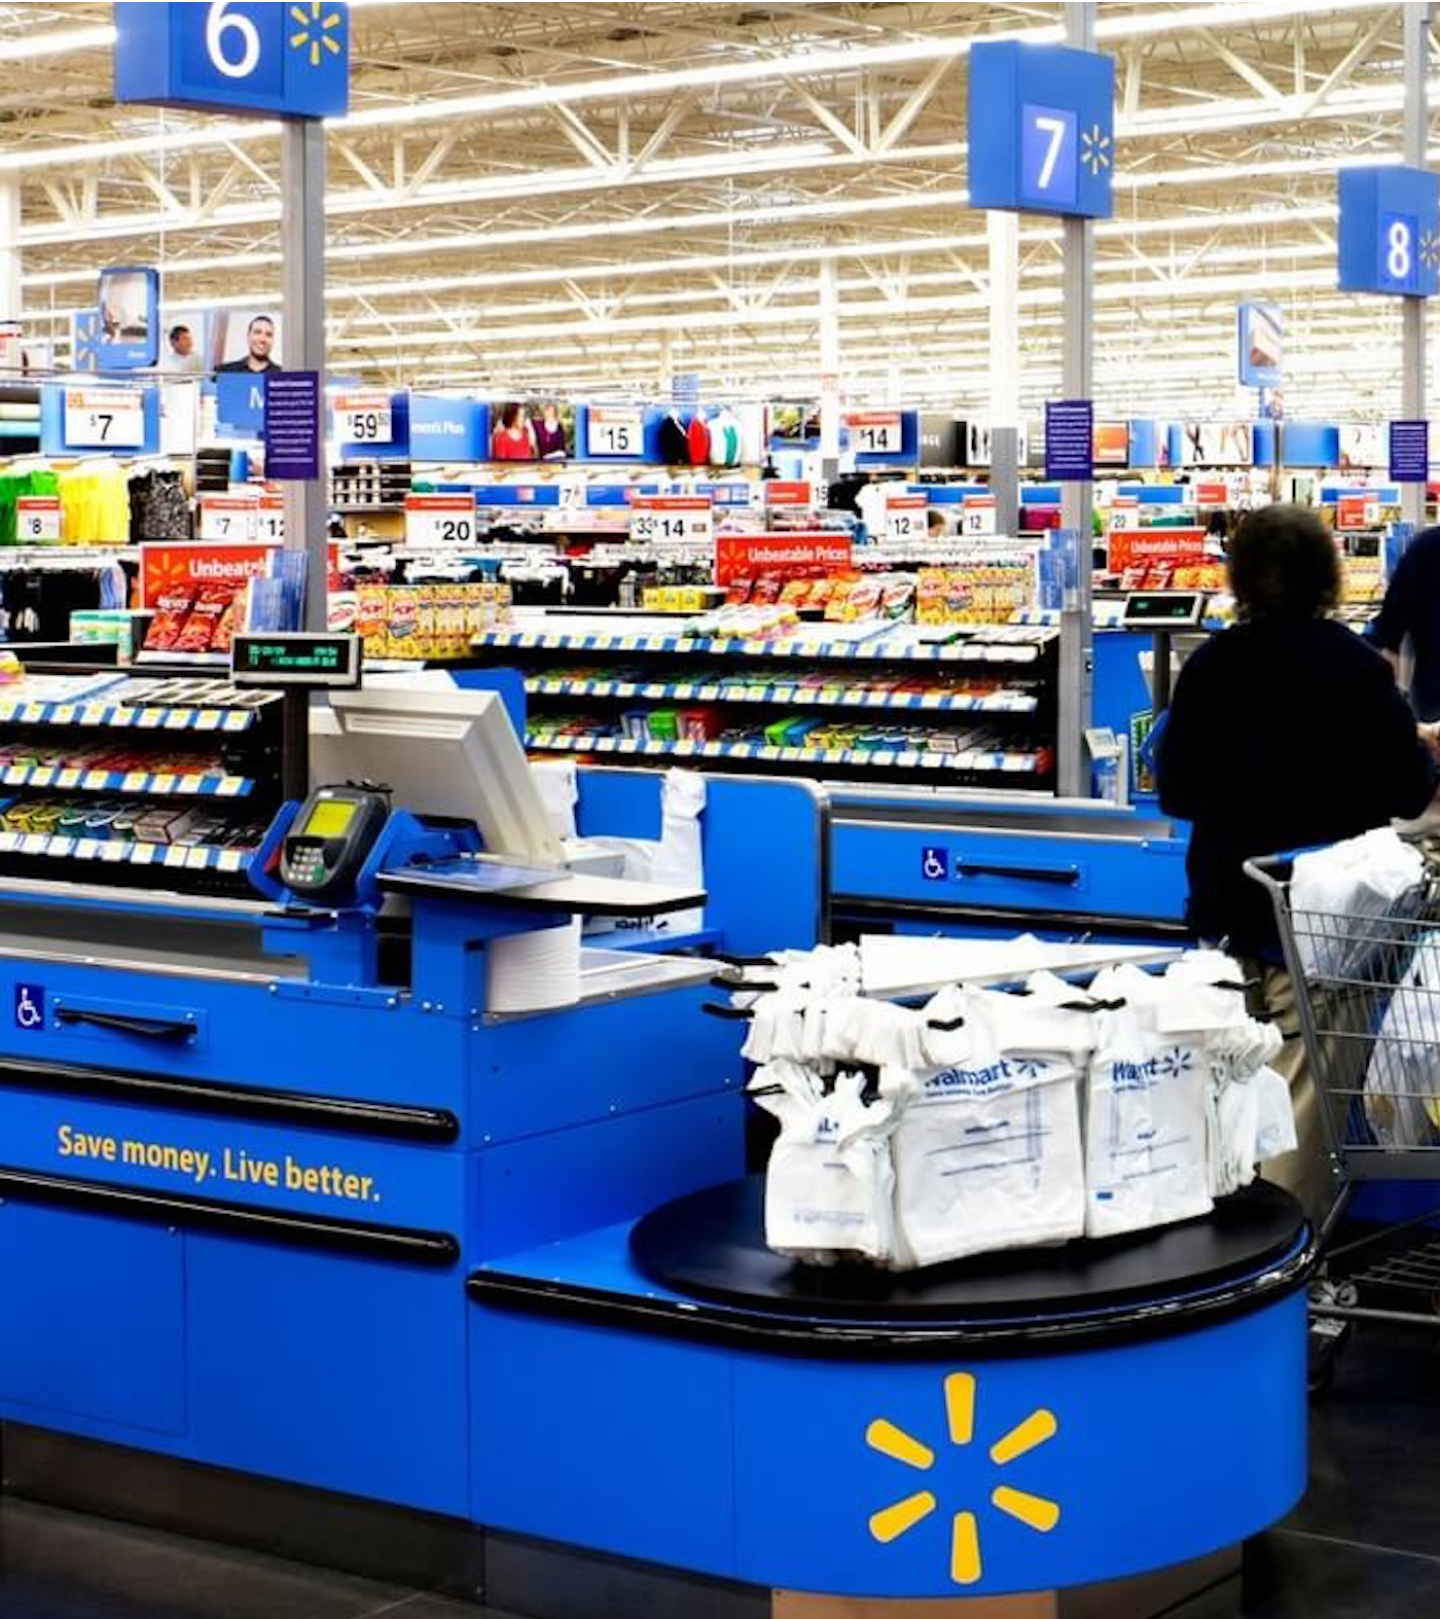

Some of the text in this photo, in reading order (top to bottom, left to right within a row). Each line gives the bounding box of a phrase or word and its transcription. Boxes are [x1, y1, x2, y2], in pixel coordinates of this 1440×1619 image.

[206, 2, 262, 79] 6
[1034, 116, 1066, 190] 7
[1386, 221, 1412, 279] 8
[748, 546, 848, 564] Unbeatable Prices
[57, 1125, 381, 1202] Save money. Live better.
